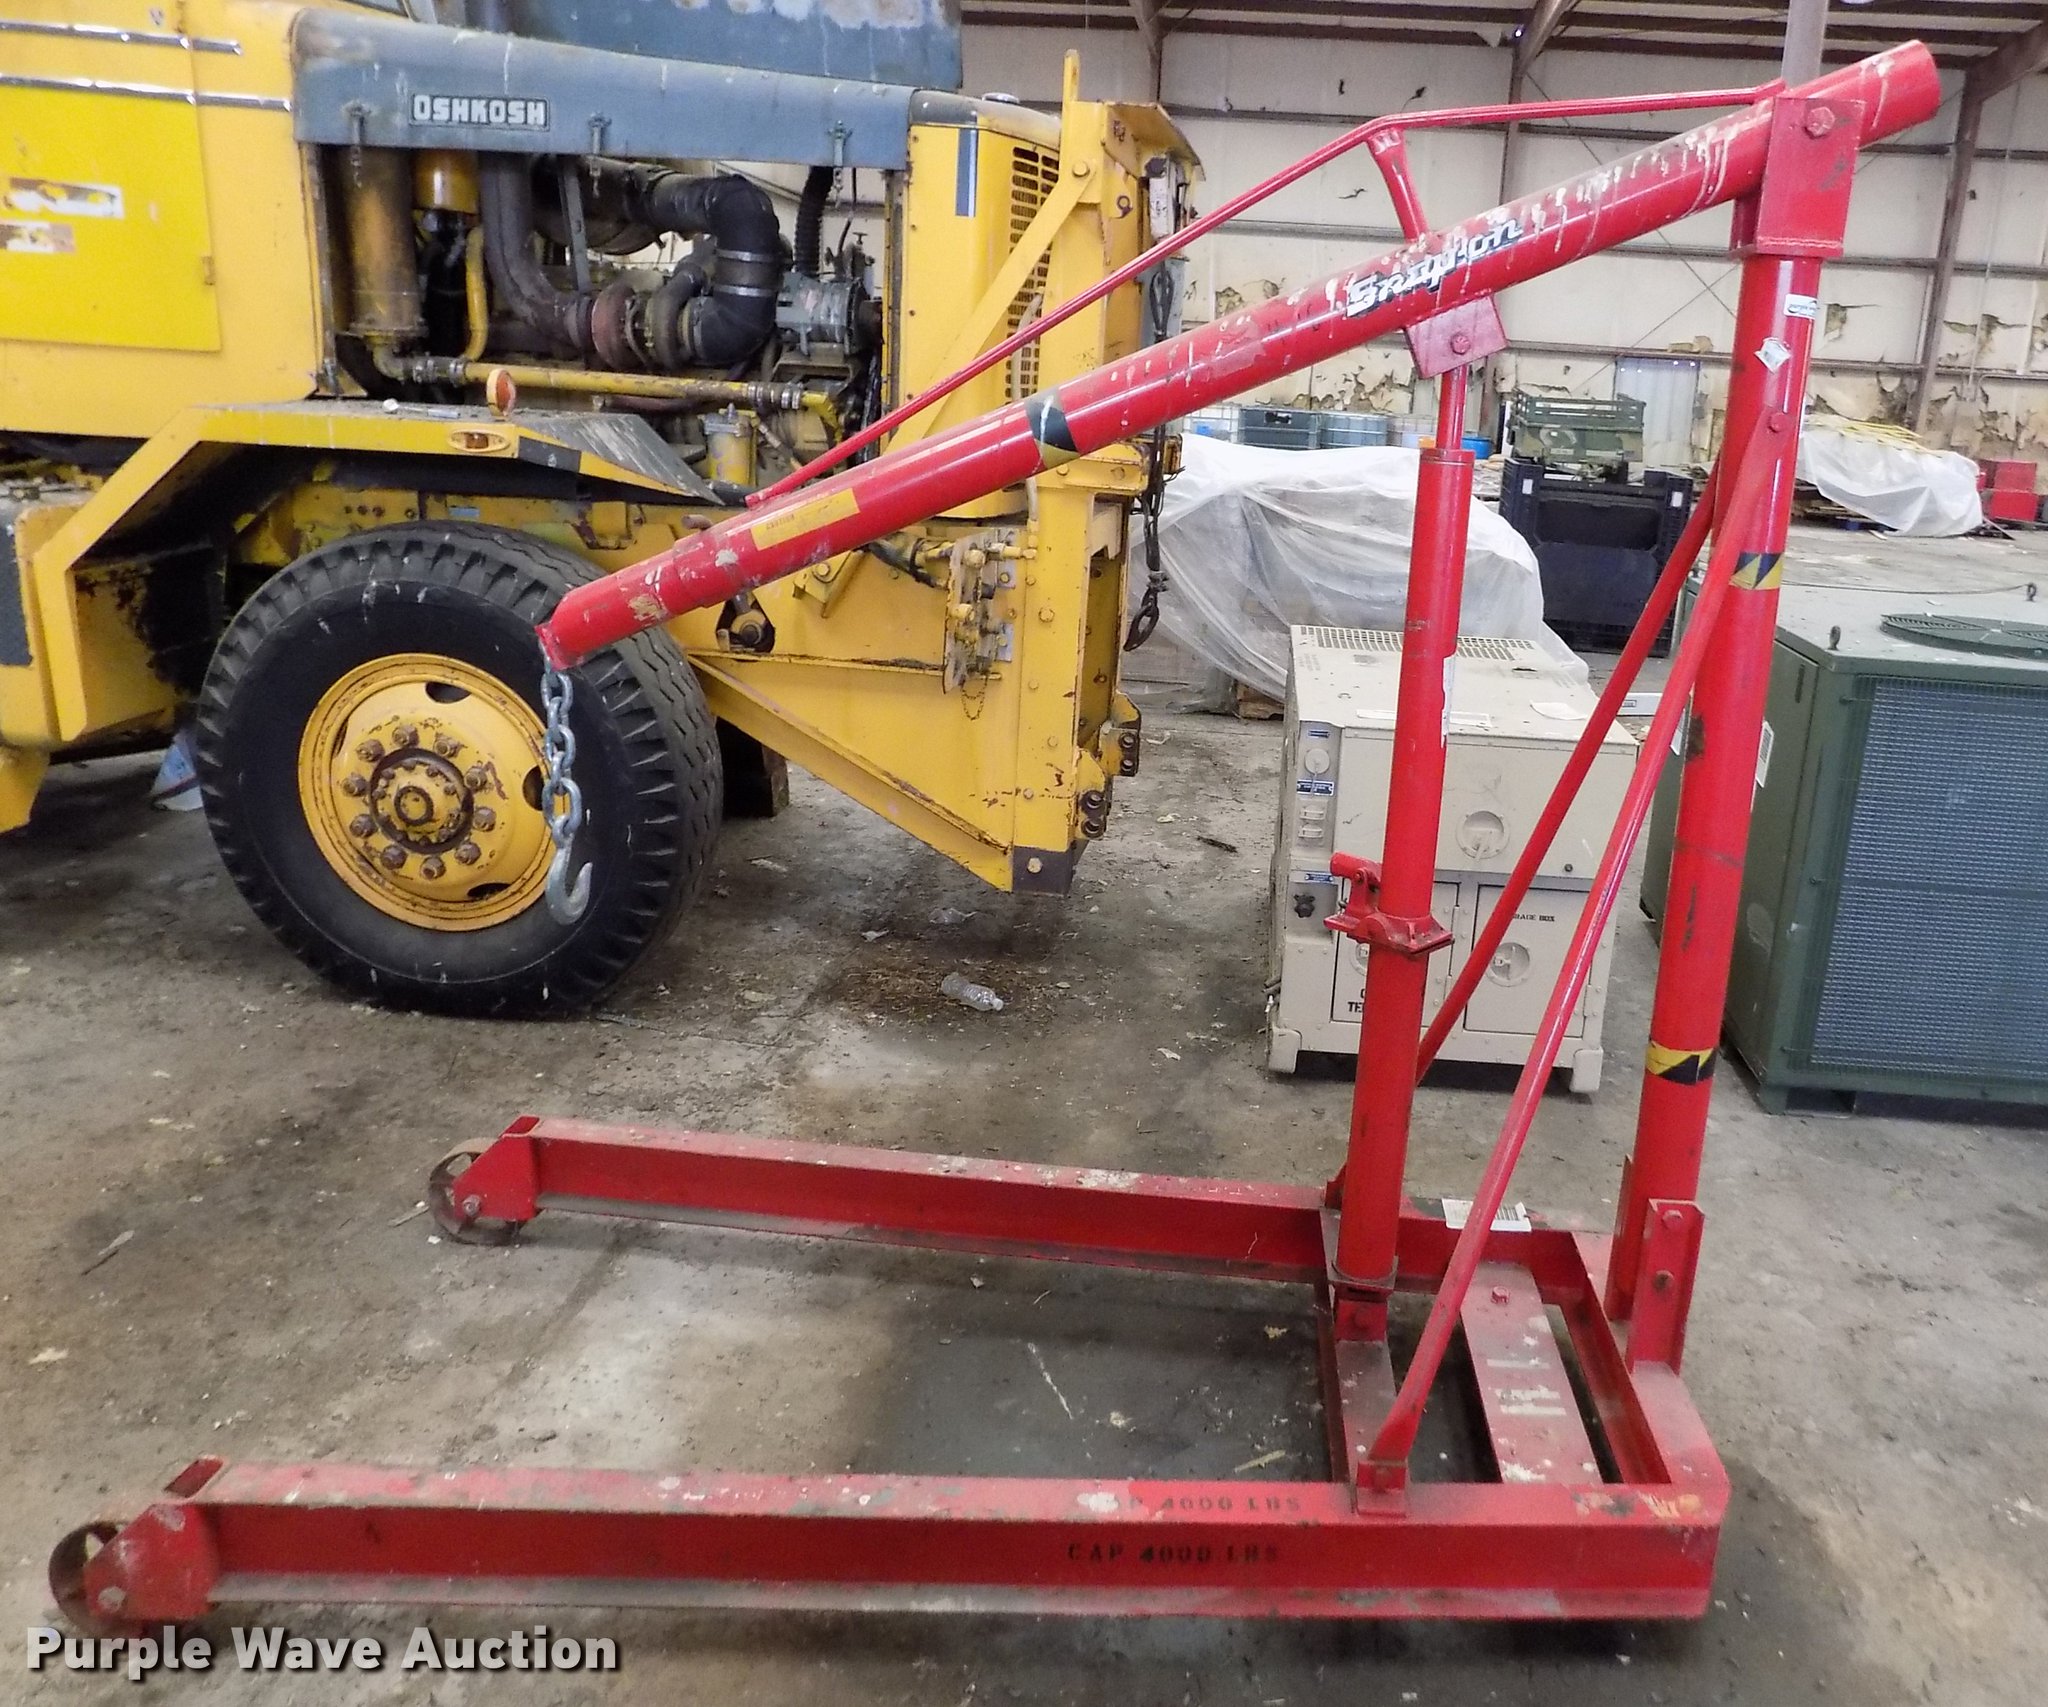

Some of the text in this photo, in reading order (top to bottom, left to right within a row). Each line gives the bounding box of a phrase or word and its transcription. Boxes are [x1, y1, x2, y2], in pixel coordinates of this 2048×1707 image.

[413, 95, 546, 125] OSHKOSH
[1162, 1497, 1233, 1511] 4000
[1067, 1543, 1123, 1562] CAP
[1139, 1544, 1212, 1563] 4000
